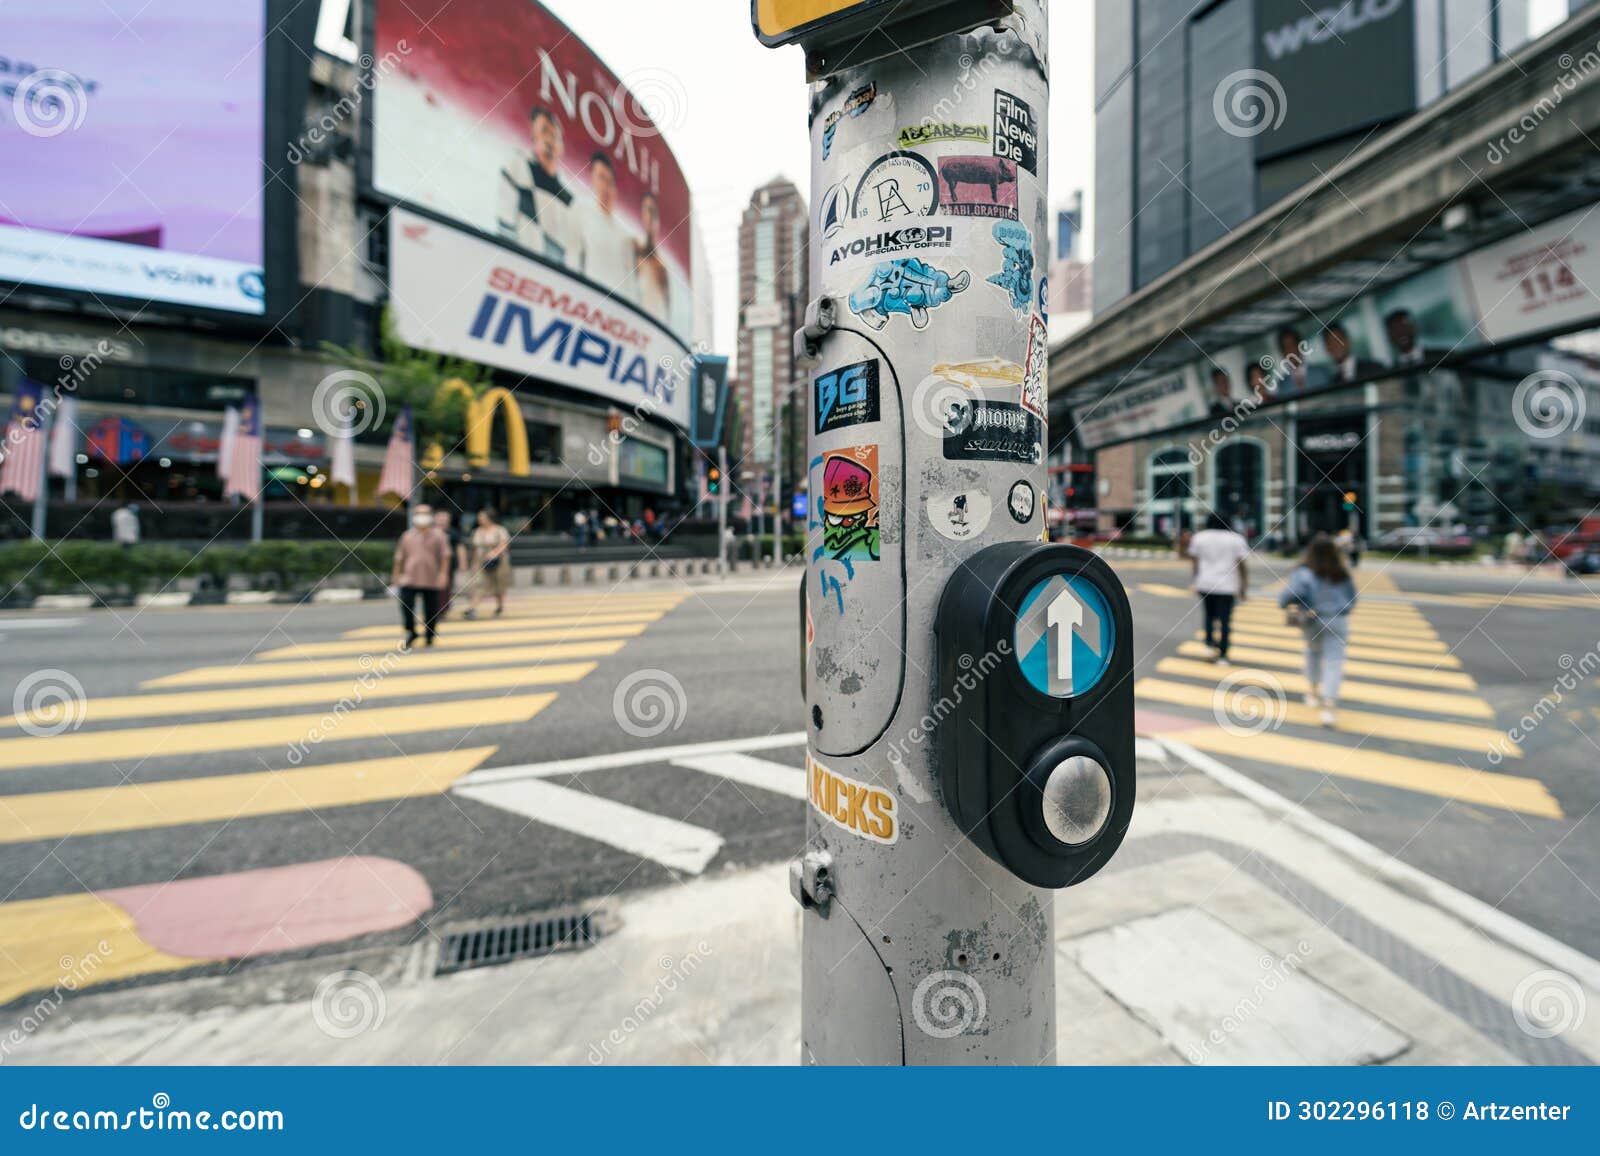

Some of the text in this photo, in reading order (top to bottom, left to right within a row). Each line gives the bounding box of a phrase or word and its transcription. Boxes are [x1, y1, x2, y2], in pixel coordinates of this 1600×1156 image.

[997, 94, 1028, 125] Film
[995, 136, 1023, 162] Die
[997, 114, 1037, 151] Never
[916, 182, 930, 193] 70
[865, 241, 951, 258] SPECIALTY COFFEE
[487, 267, 651, 350] SEMANGAT
[469, 293, 677, 404] IMPIAN
[819, 365, 867, 432] BG
[813, 762, 894, 839] KICKS
